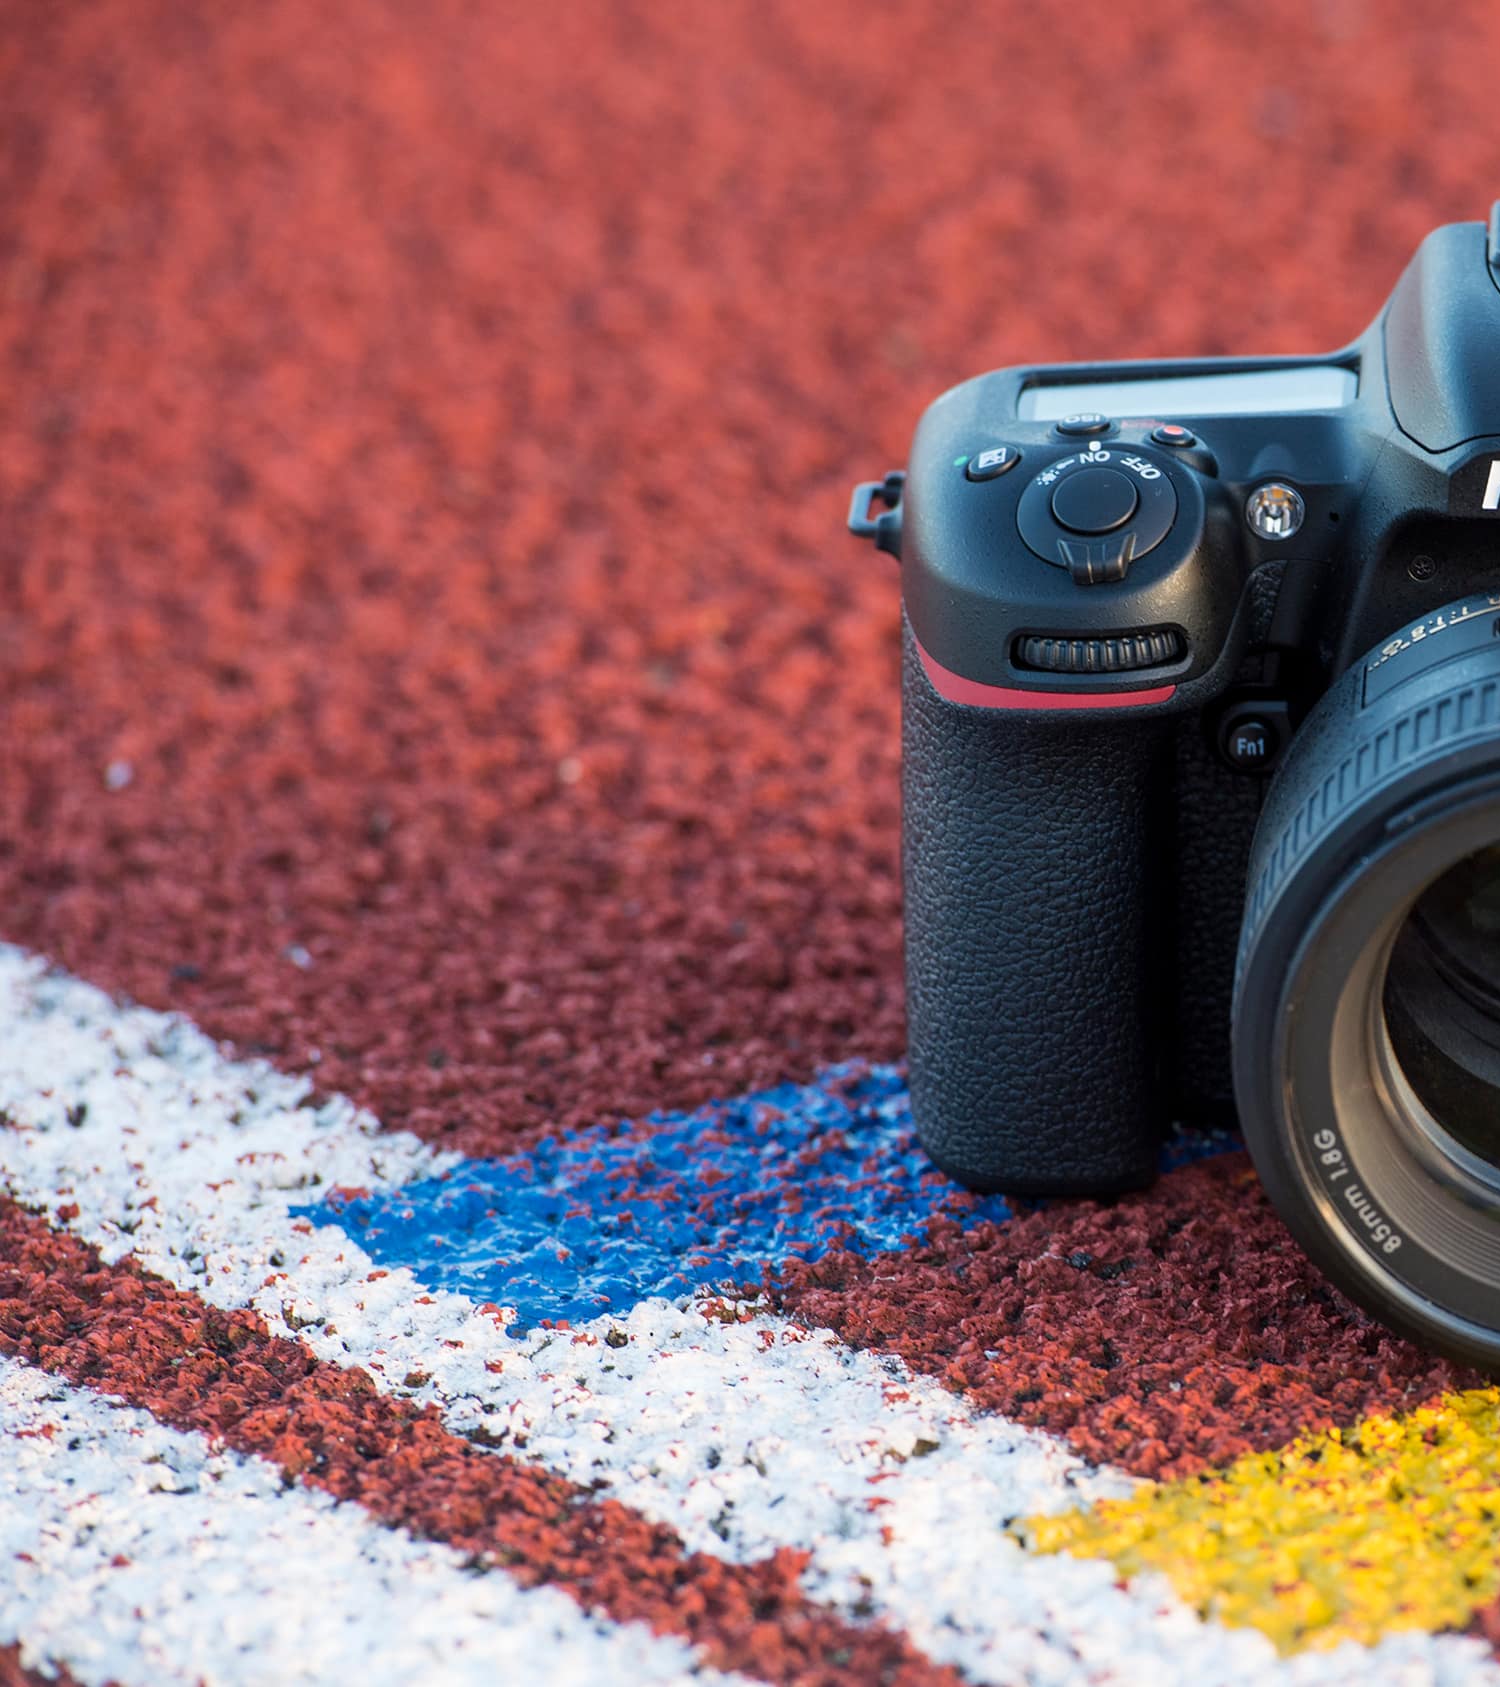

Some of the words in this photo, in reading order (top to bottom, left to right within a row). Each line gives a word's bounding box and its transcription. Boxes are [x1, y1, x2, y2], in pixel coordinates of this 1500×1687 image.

[1064, 414, 1100, 424] ISO
[1079, 450, 1111, 465] ON
[1119, 455, 1162, 480] OFF
[1236, 736, 1266, 756] Fn1
[1313, 1128, 1349, 1181] 1.8G
[1343, 1183, 1402, 1254] 85mm
